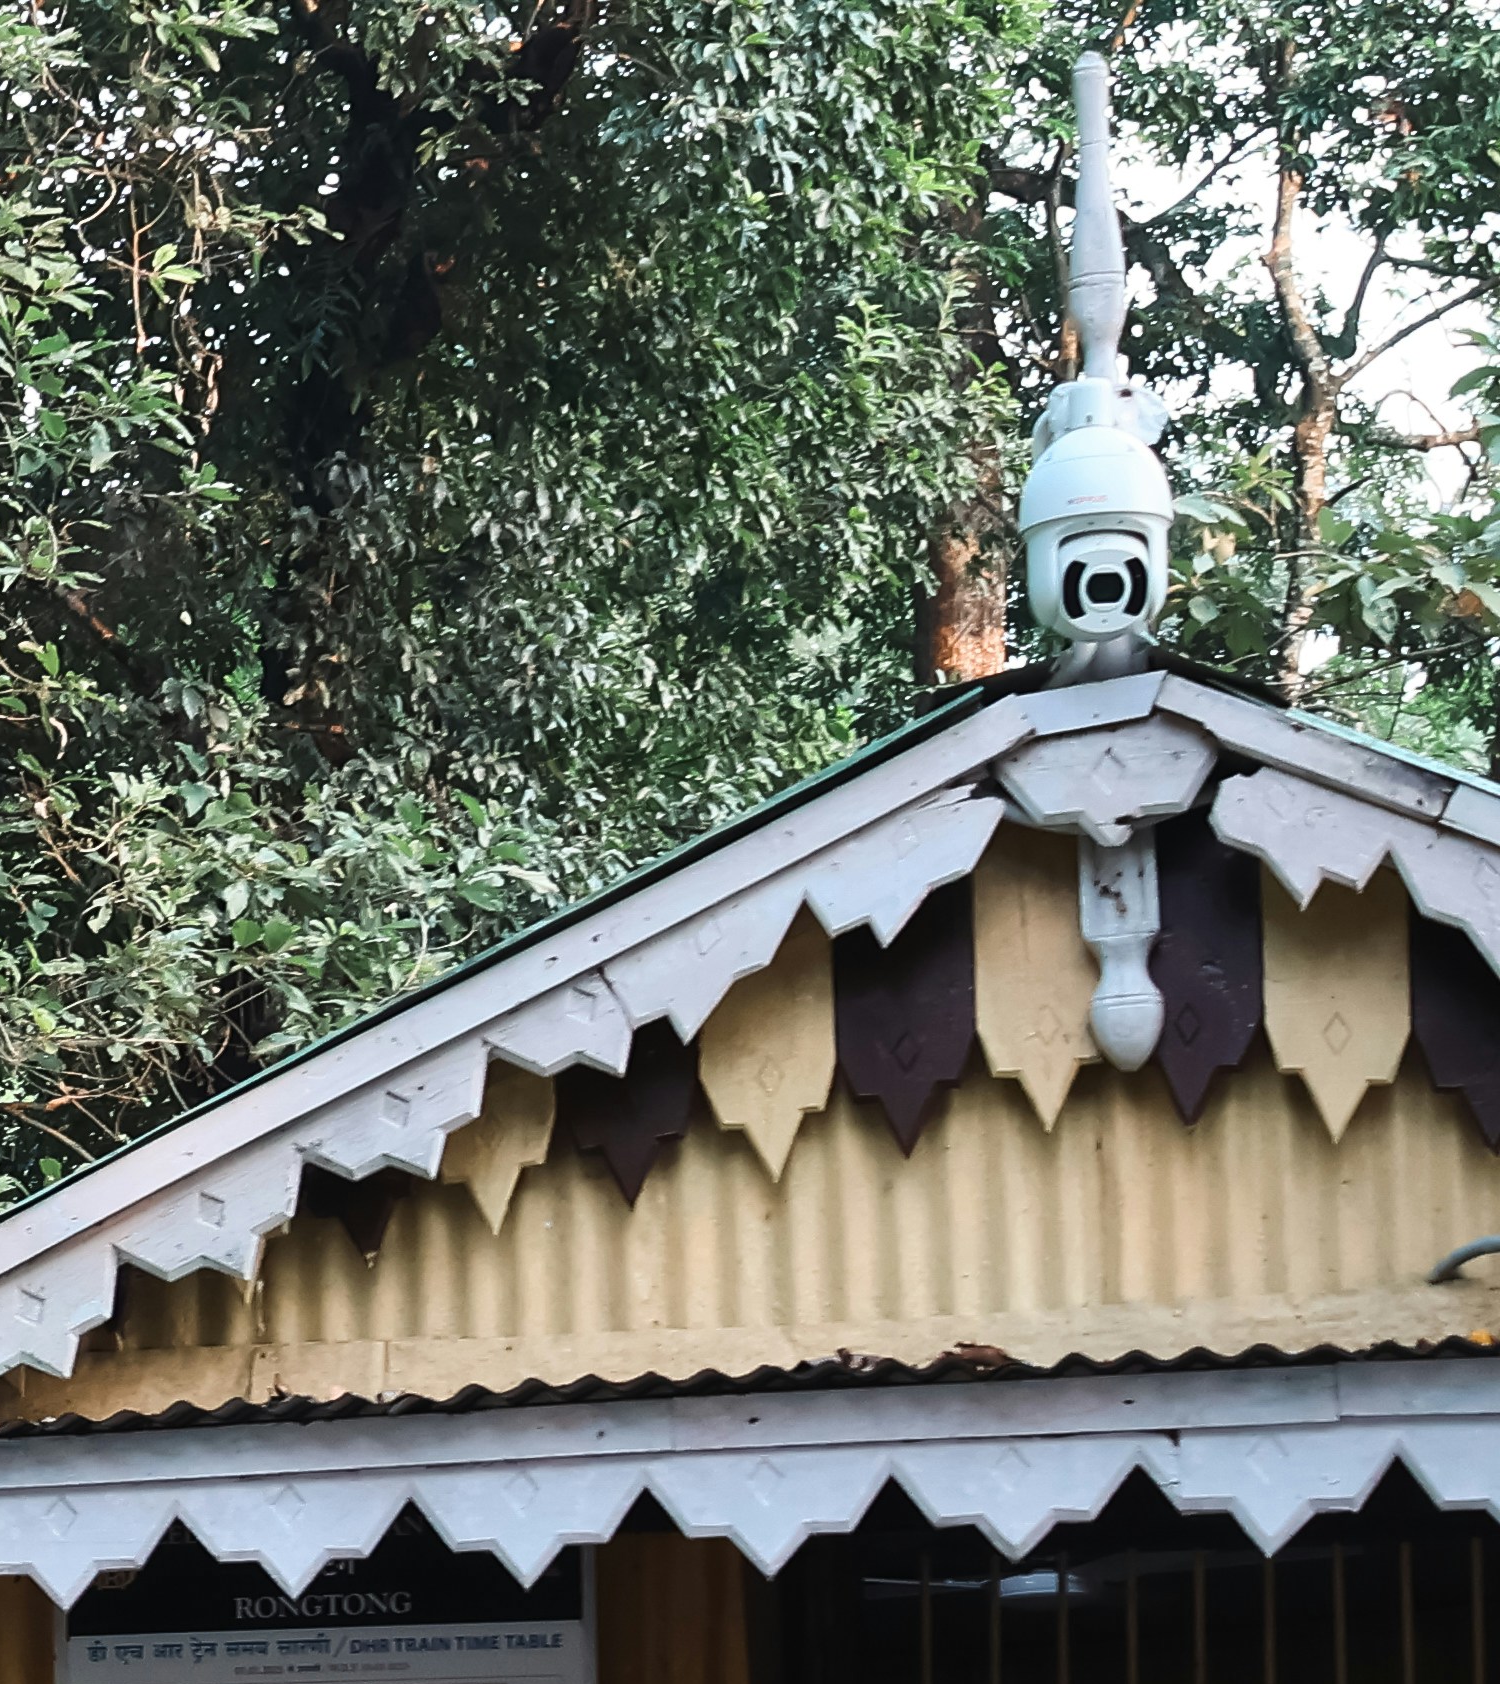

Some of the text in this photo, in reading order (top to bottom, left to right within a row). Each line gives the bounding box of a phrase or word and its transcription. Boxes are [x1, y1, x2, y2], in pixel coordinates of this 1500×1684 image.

[235, 1592, 412, 1619] RONGTONG
[394, 1636, 451, 1653] TRAIN
[455, 1634, 499, 1651] TIME
[504, 1632, 564, 1649] TABLE
